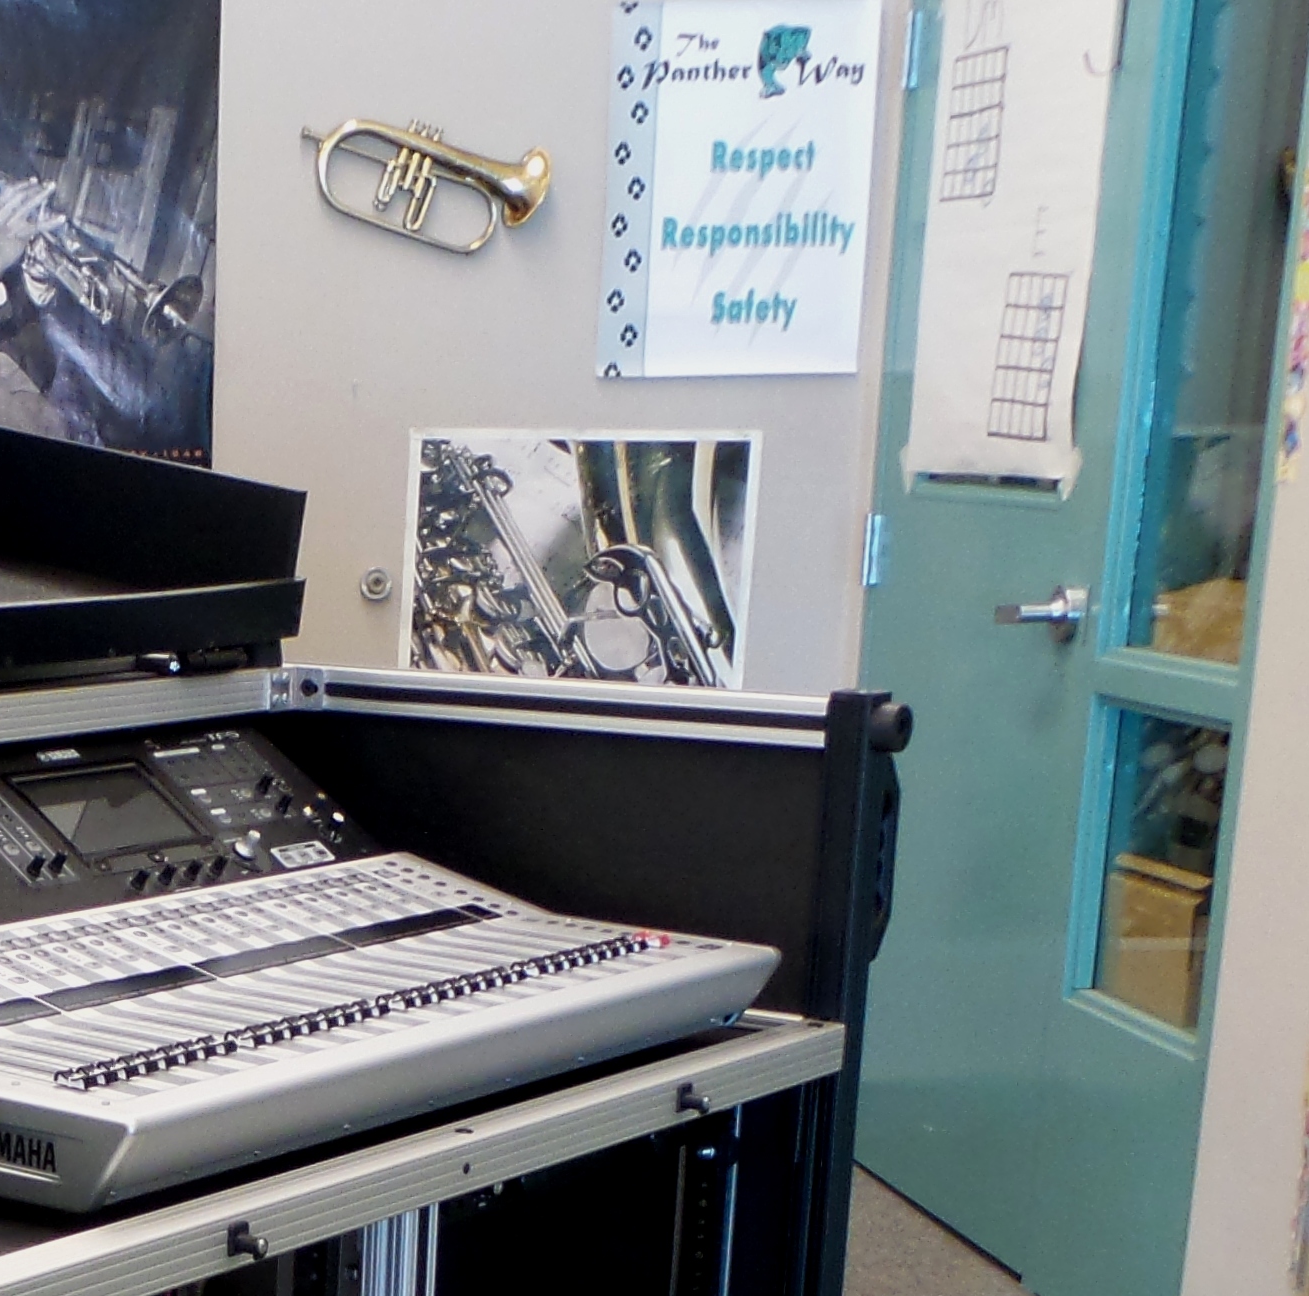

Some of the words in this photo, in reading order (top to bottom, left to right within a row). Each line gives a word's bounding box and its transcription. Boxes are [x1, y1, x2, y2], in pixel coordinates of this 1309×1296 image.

[677, 33, 719, 56] The
[642, 58, 752, 90] Panther
[796, 55, 865, 86] Way
[711, 140, 815, 180] Respect
[661, 212, 854, 257] Responsibility
[711, 288, 796, 331] Safety
